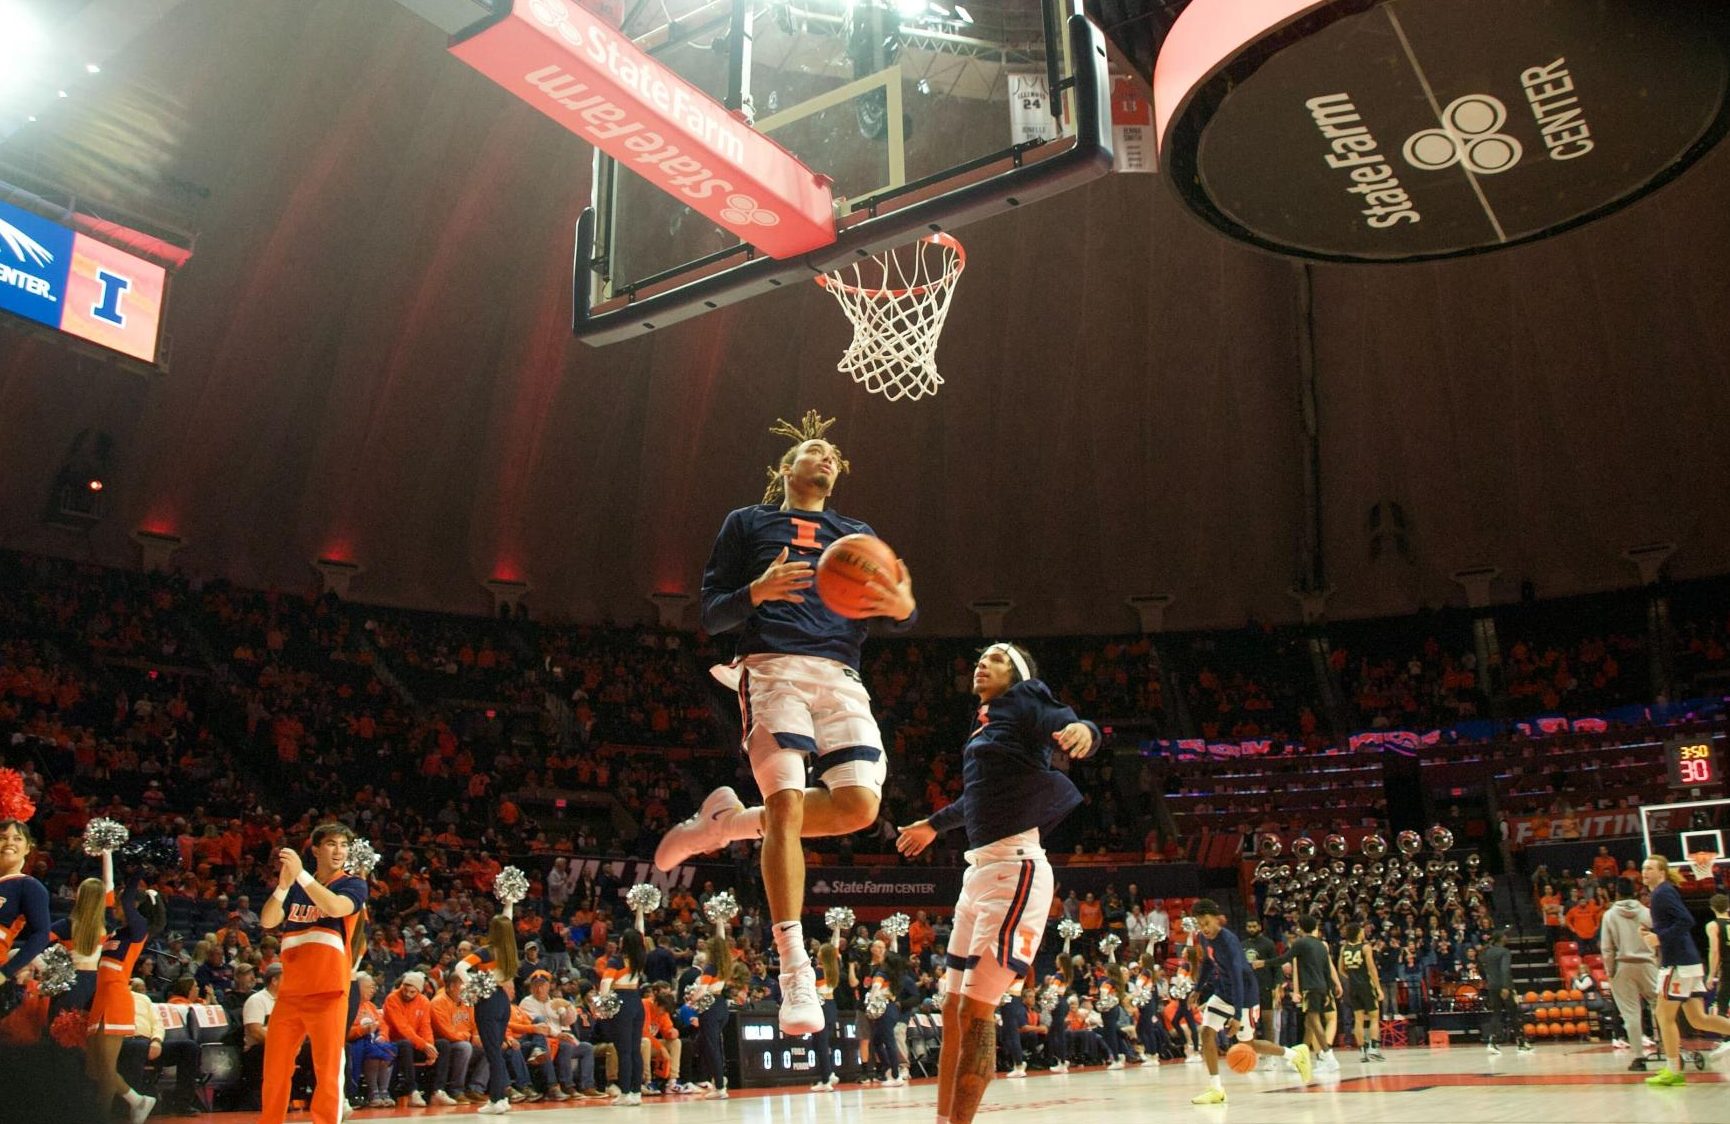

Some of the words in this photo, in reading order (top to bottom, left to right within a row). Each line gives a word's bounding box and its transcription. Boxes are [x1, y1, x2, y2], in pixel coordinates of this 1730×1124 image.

[1023, 98, 1041, 109] 24
[1520, 57, 1595, 160] CENTER
[91, 266, 132, 329] I
[790, 517, 823, 550] I
[1680, 744, 1708, 759] 3:50
[1680, 759, 1709, 782] 30
[895, 883, 935, 893] CENTER
[1344, 950, 1363, 965] 24
[763, 1051, 772, 1070] 0
[783, 1050, 791, 1069] 0
[808, 1049, 815, 1067] 0
[834, 1048, 842, 1067] 0
